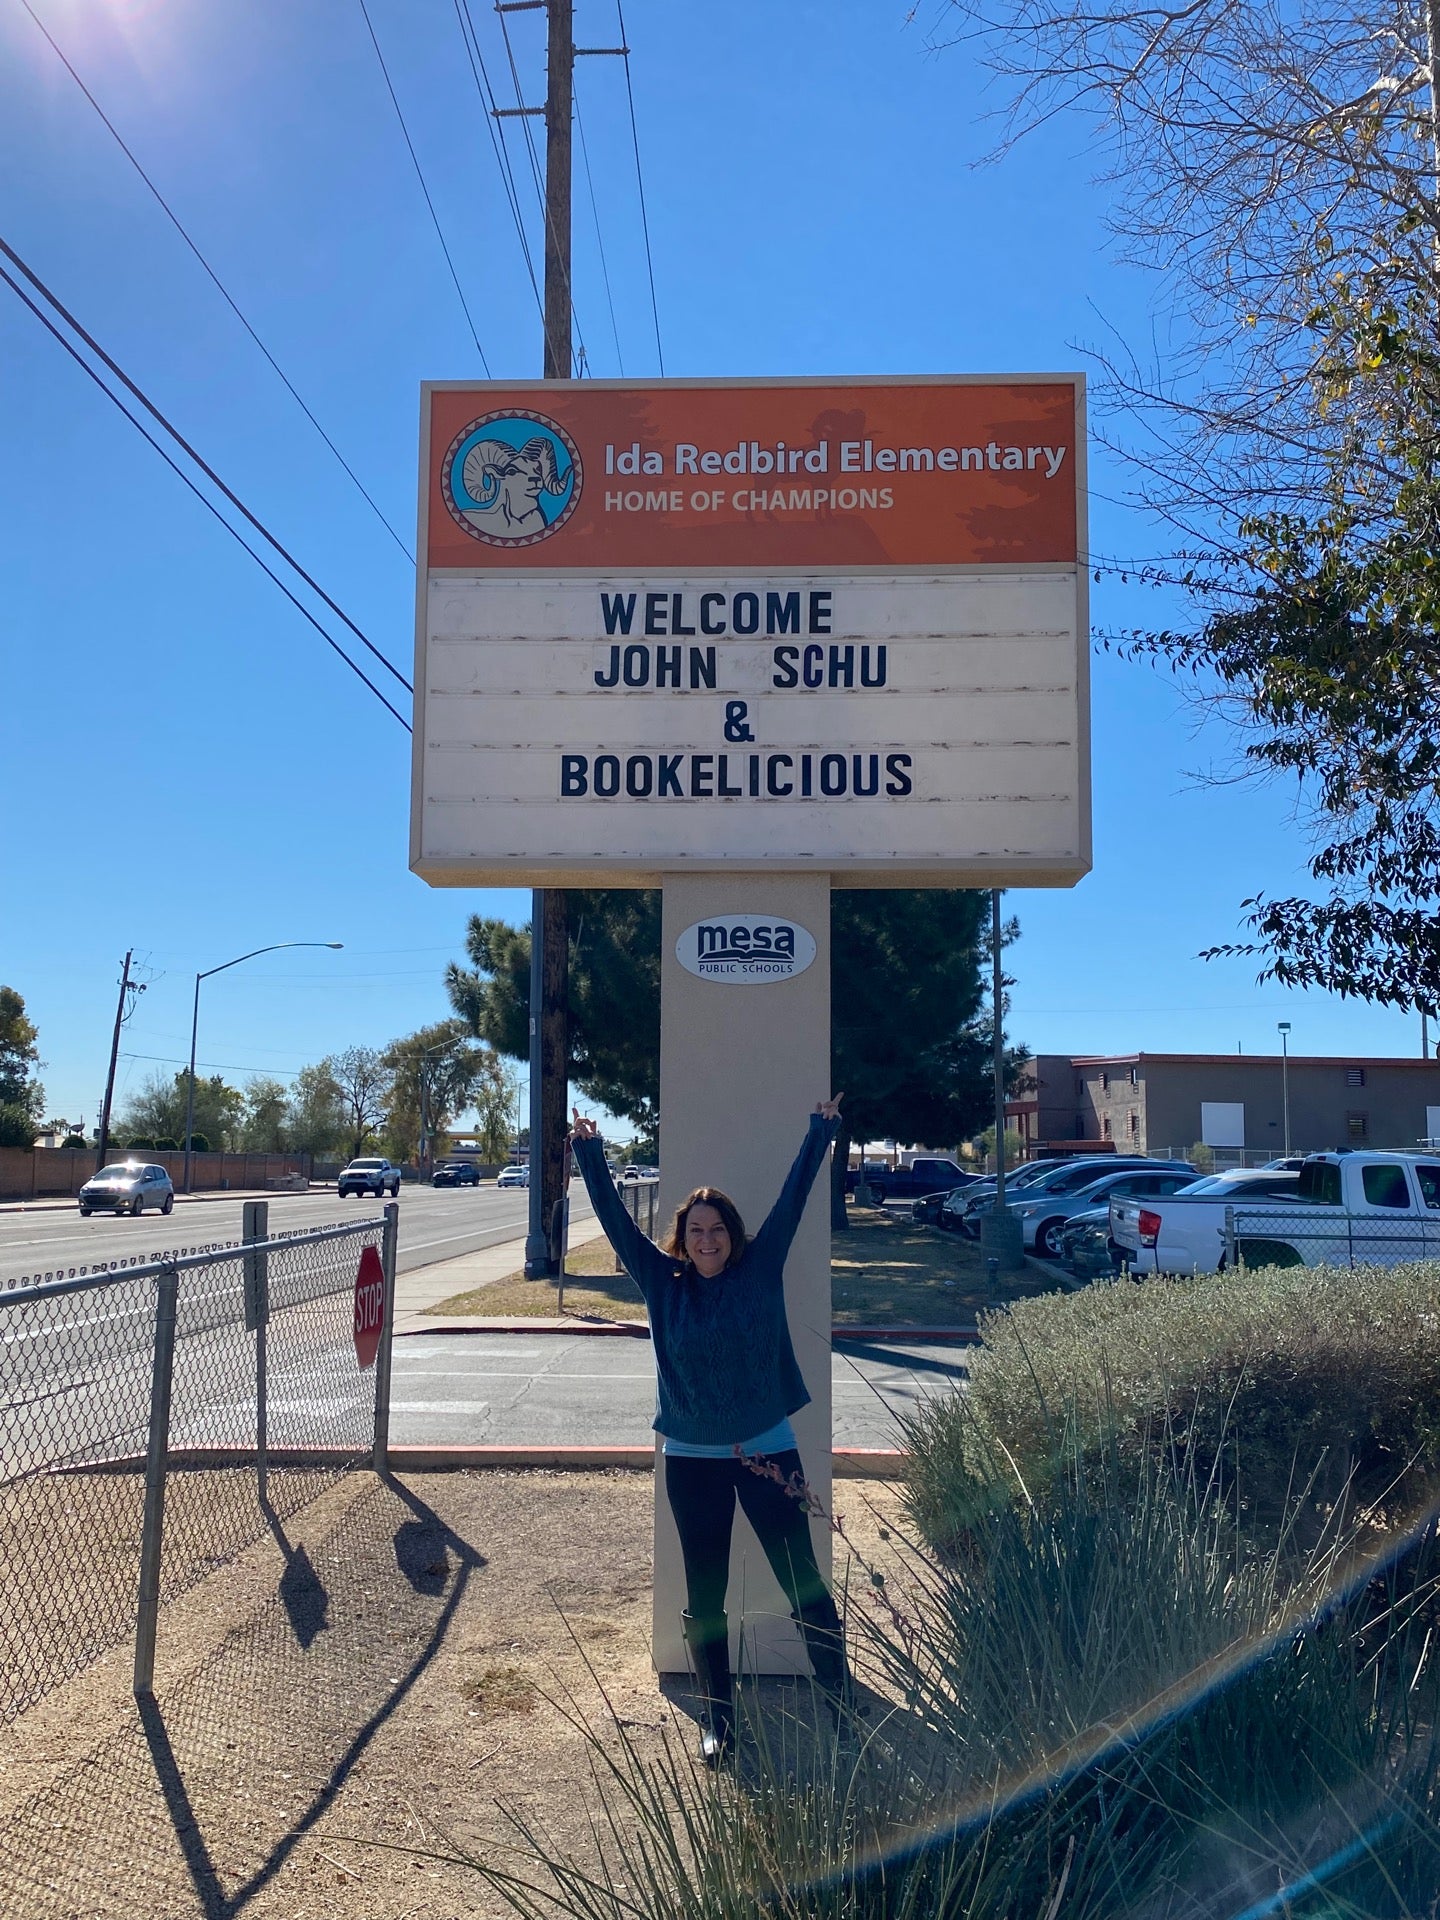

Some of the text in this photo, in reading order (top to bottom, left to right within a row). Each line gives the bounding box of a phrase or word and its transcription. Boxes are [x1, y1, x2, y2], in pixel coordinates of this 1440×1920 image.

[604, 440, 1066, 479] Ida Redbird Elementary
[604, 487, 895, 513] HOME OF CHAMPIONS
[601, 591, 833, 635] WELCOME
[594, 644, 887, 689] JOHN SCHU
[724, 701, 755, 743] &
[561, 754, 912, 797] BOOKELICIOUS
[698, 926, 794, 957] mesa
[699, 964, 793, 973] PUBLIC SCHOOLS
[357, 1281, 383, 1333] STOP
